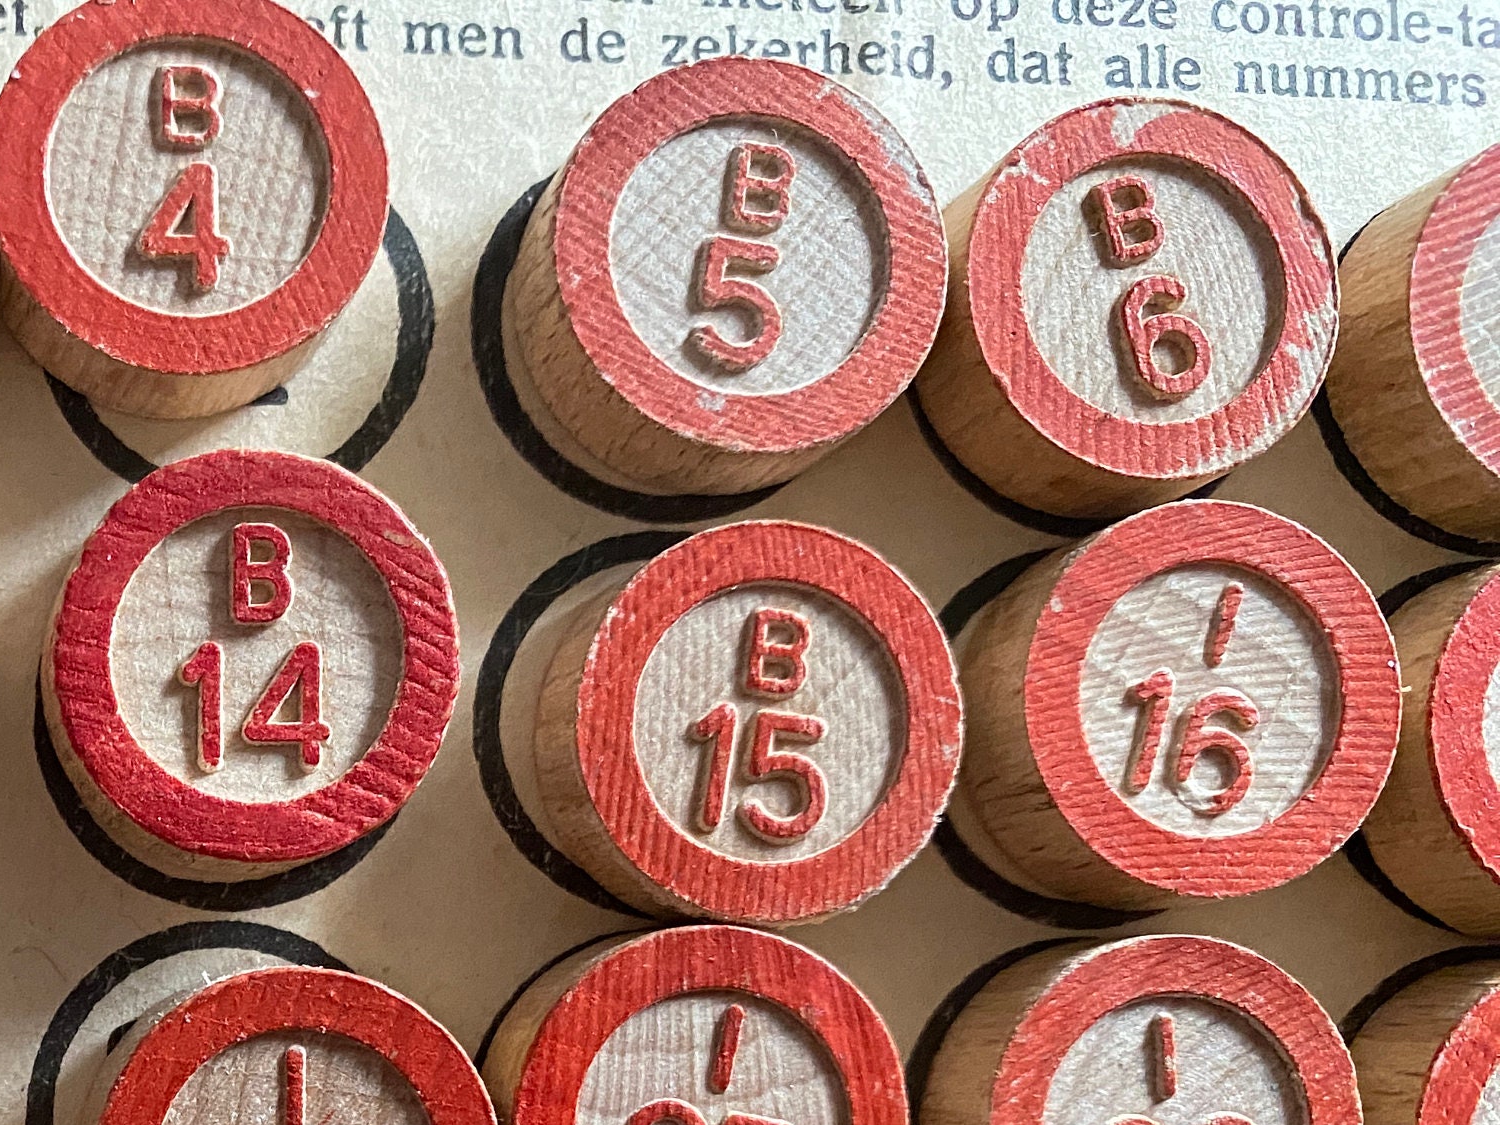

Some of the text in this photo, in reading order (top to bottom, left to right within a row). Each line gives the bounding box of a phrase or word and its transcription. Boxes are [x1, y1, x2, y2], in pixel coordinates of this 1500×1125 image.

[402, 20, 524, 60] men
[560, 17, 627, 64] de
[662, 24, 953, 91] zekerheid,
[987, 37, 1072, 86] dat
[1104, 43, 1202, 92] alle
[1233, 60, 1488, 107] nummers
[952, 0, 1018, 32] op
[1052, 0, 1178, 30] deze
[160, 64, 224, 145] B
[138, 161, 231, 292] 4
[731, 141, 795, 228] B
[1100, 174, 1164, 266] B
[697, 233, 781, 371] 5
[1119, 274, 1211, 398] 6
[229, 522, 291, 625] B
[747, 607, 810, 696] B
[179, 640, 331, 774] 14
[1134, 667, 1259, 816] 16
[691, 701, 828, 845] 15
